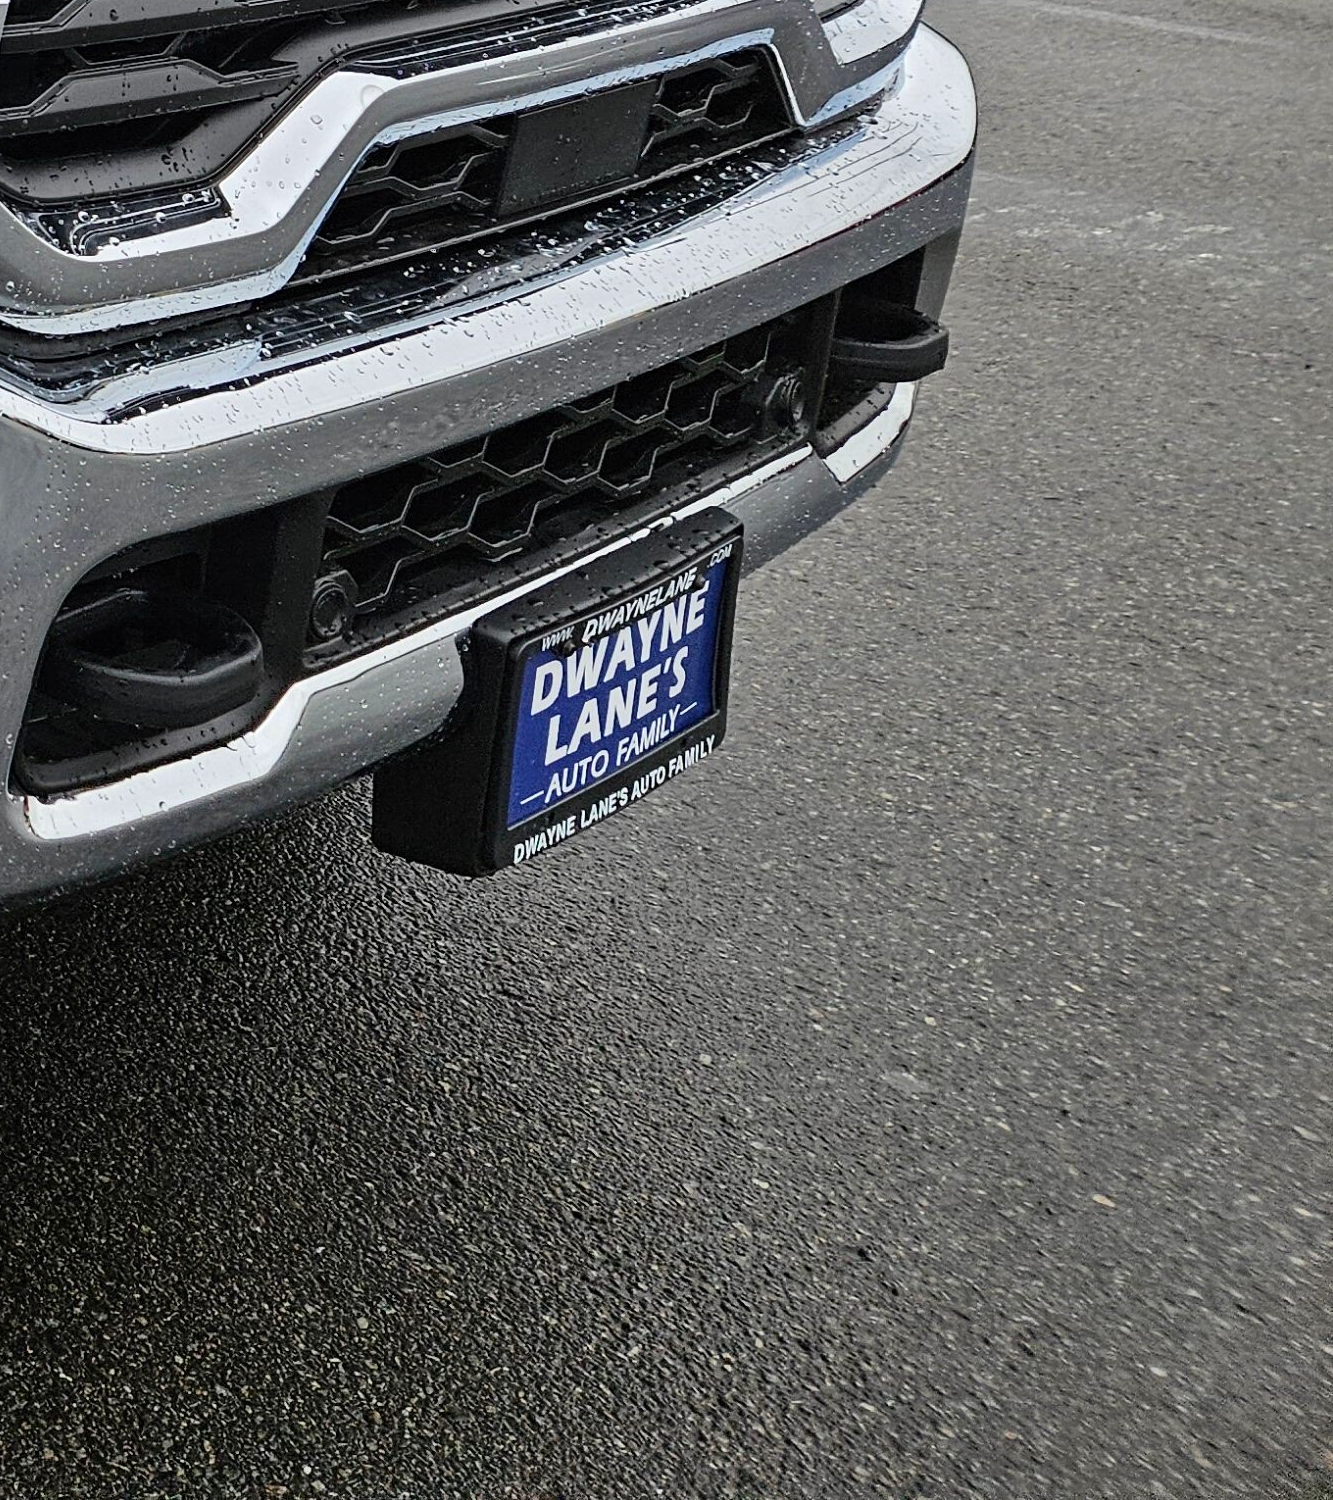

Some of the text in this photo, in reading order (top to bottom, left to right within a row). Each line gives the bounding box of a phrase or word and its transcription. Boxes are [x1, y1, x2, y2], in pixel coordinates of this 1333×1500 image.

[531, 580, 710, 716] DWAYNE
[544, 646, 689, 766] LANE'S
[513, 734, 717, 864] DWAYNE LANE'S AUTO FAMILY
[544, 707, 681, 803] AUTO FAMILY
